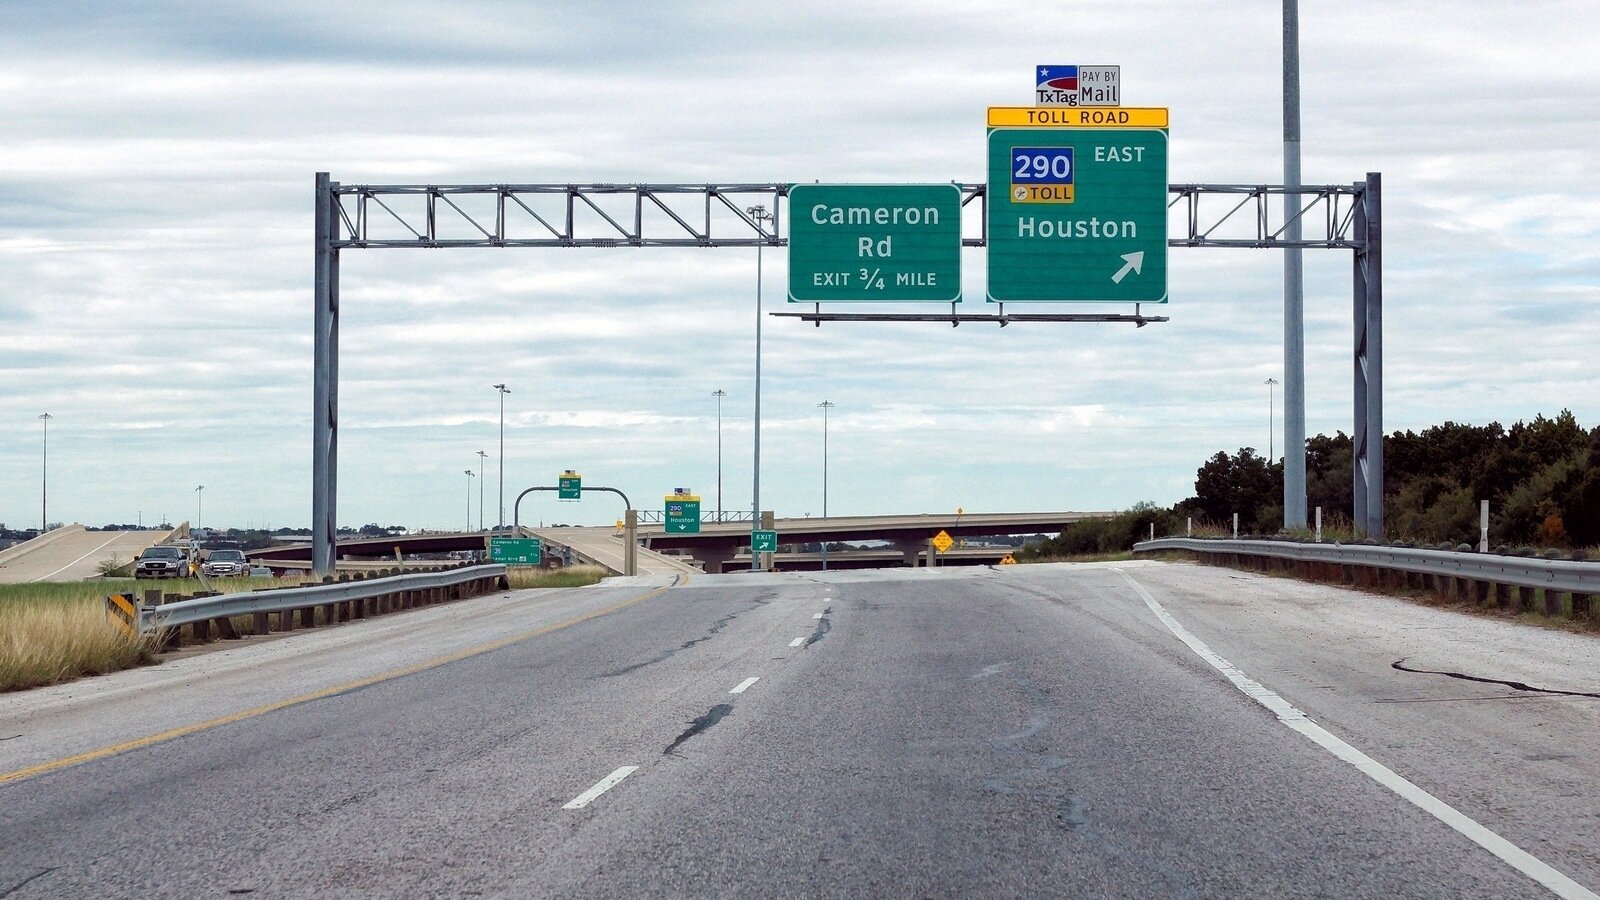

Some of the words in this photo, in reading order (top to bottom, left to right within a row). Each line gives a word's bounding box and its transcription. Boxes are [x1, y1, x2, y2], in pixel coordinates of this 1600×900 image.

[1082, 71, 1100, 82] PAY
[1104, 71, 1117, 82] BY
[1036, 90, 1078, 106] TxTag
[1081, 85, 1117, 102] Mail
[1027, 111, 1070, 124] TOLL
[1080, 111, 1129, 124] ROAD
[1094, 146, 1145, 162] EAST
[1015, 155, 1071, 179] 290
[1030, 187, 1071, 200] TOLL
[811, 204, 939, 225] Cameron
[1018, 217, 1137, 238] Houston
[858, 236, 892, 257] Rd
[813, 273, 850, 286] EXIT
[896, 273, 937, 286] MILE
